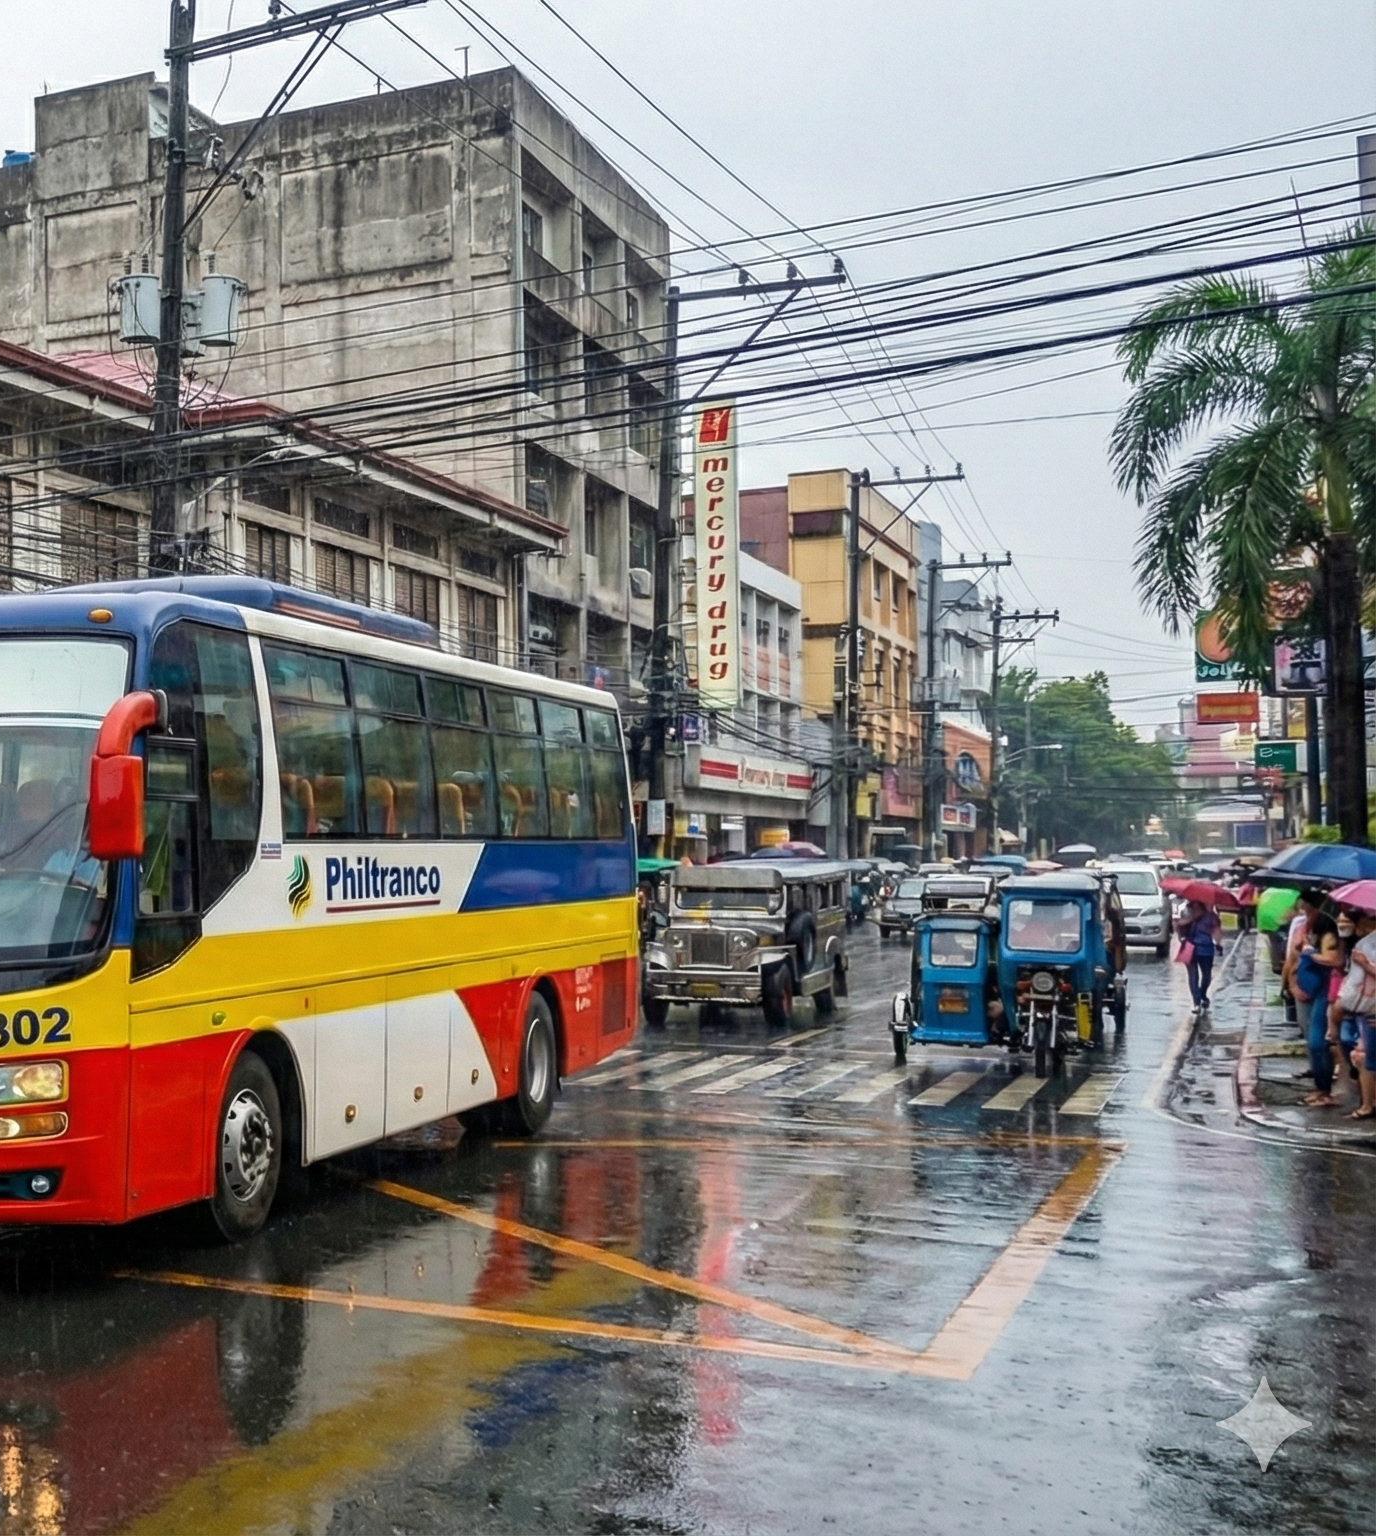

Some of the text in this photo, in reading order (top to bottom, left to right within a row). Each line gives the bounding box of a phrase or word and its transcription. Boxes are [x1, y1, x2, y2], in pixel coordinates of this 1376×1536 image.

[702, 456, 729, 593] mercury
[707, 601, 729, 680] drug
[325, 856, 441, 901] Philtranco
